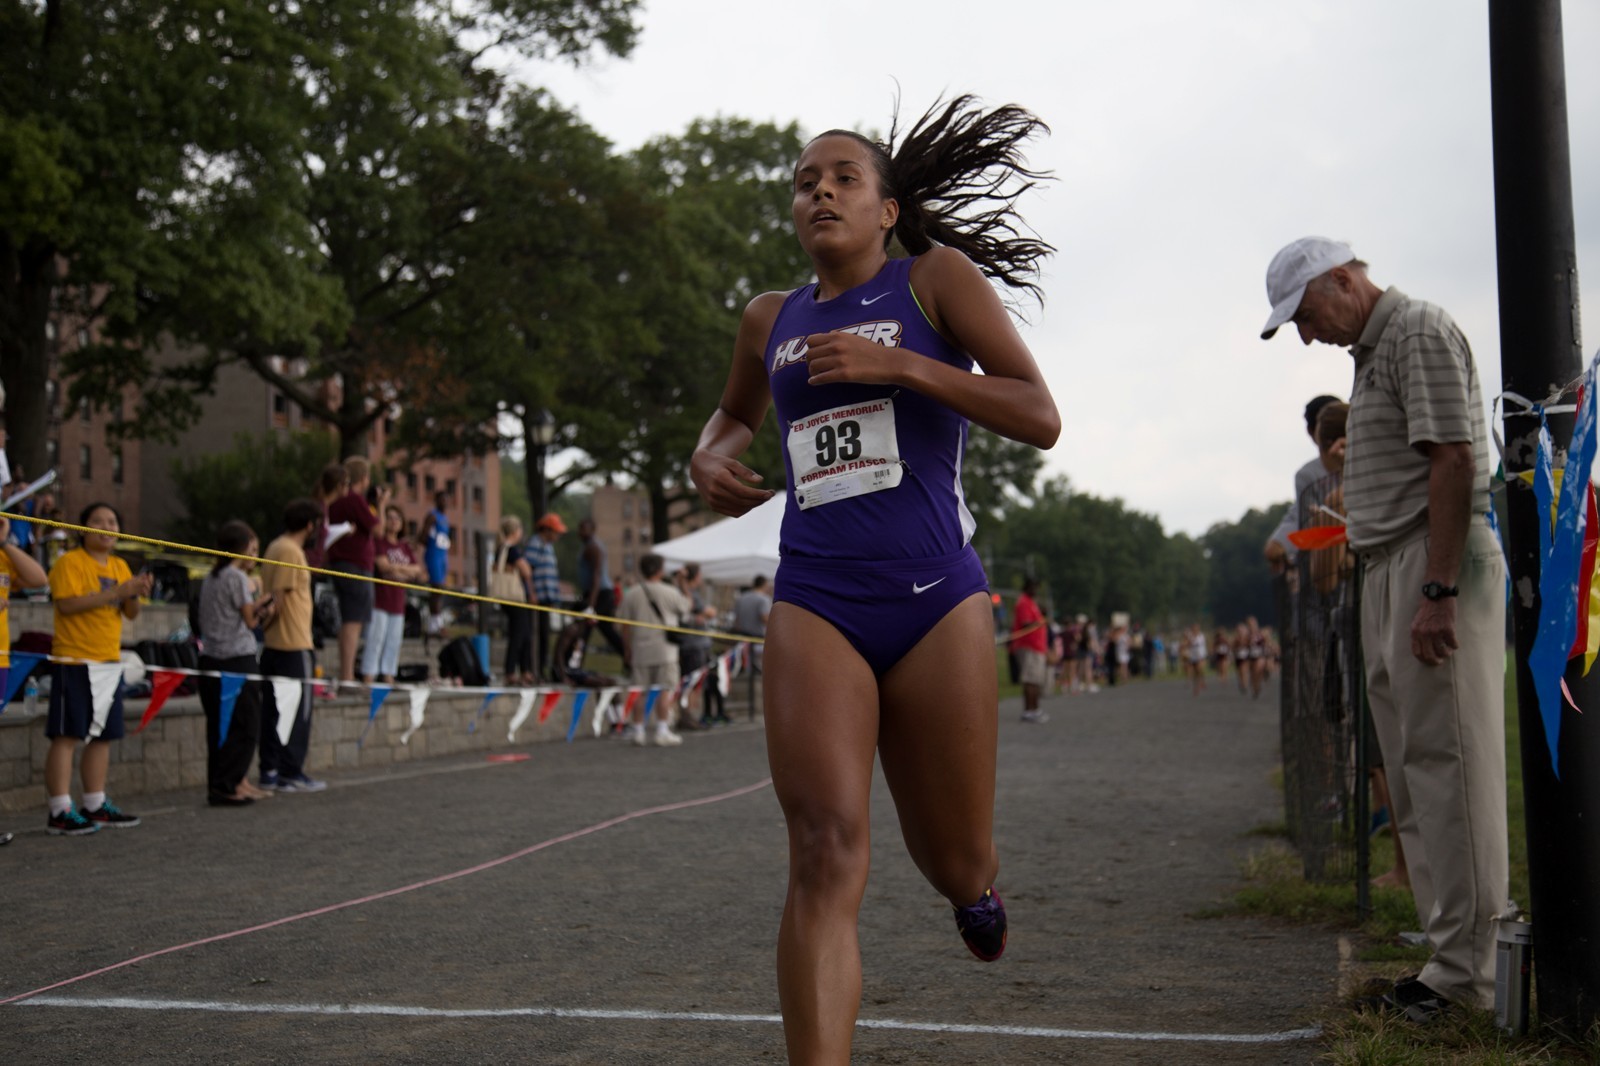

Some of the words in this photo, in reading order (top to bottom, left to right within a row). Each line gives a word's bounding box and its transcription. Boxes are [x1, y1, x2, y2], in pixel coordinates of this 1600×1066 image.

[794, 423, 804, 433] ED
[806, 414, 830, 429] JOYCE
[832, 403, 885, 420] MEMORIAL
[815, 420, 862, 467] 93
[801, 464, 847, 484] FORDHAM
[848, 457, 887, 471] FIASCO
